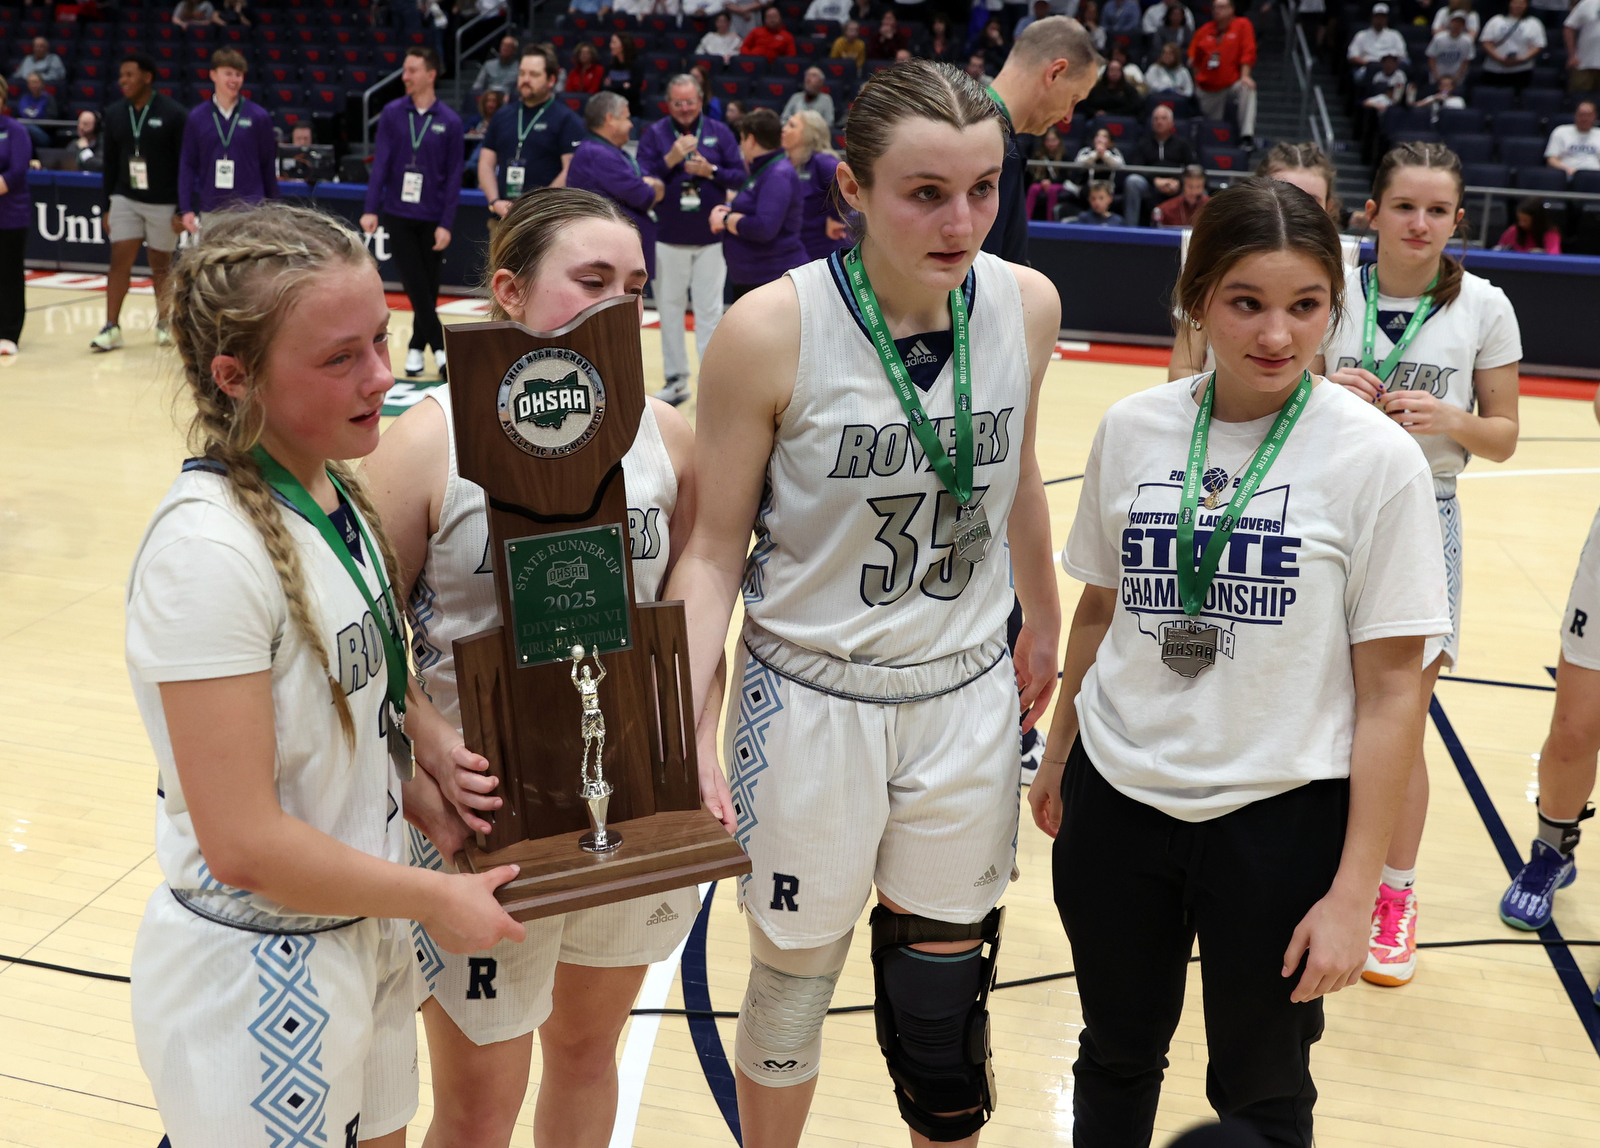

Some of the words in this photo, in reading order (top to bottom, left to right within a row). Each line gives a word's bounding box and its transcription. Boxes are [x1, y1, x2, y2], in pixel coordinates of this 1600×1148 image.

[853, 270, 863, 286] OHIO
[859, 287, 868, 303] HIGH
[865, 304, 880, 329] SCHOOL
[875, 331, 894, 360] ATHLETIC
[889, 362, 913, 401] ASSOCIATION
[957, 310, 965, 340] ATHLETIC
[504, 363, 524, 386] OHIO
[525, 350, 552, 365] HIGH
[557, 350, 593, 375] SCHOOL
[905, 354, 938, 367] adidas
[959, 343, 967, 385] ASSOCIATION
[518, 388, 586, 418] OHSAA
[1287, 403, 1299, 418] HIGH
[1296, 388, 1306, 403] OHIO
[502, 420, 547, 456] ATHLETIC
[551, 406, 604, 456] ASSOCIATION
[1193, 431, 1203, 458] ATHLETIC
[1272, 418, 1290, 441] SCHOOL
[1256, 443, 1276, 470] ATHLETIC
[1187, 461, 1199, 499] ASSOCIATION
[1234, 471, 1259, 508] ASSOCIATION
[1130, 511, 1179, 525] ROOTSTO
[860, 485, 990, 608] 35
[515, 549, 548, 591] STATE
[547, 539, 621, 575] RUNNER-UP
[549, 565, 586, 582] OHSAA
[543, 589, 597, 614] 2025
[1121, 576, 1297, 618] CHAMONSHIP
[522, 612, 601, 638] DIVISION
[604, 608, 623, 622] VI
[1569, 607, 1588, 638] R
[519, 640, 554, 657] GIRLS
[556, 627, 628, 651] BASKETBALL
[1166, 642, 1214, 661] OHSAA
[770, 871, 800, 912] R
[973, 873, 1000, 888] adidas
[646, 911, 680, 927] adidas
[466, 956, 497, 1000] R
